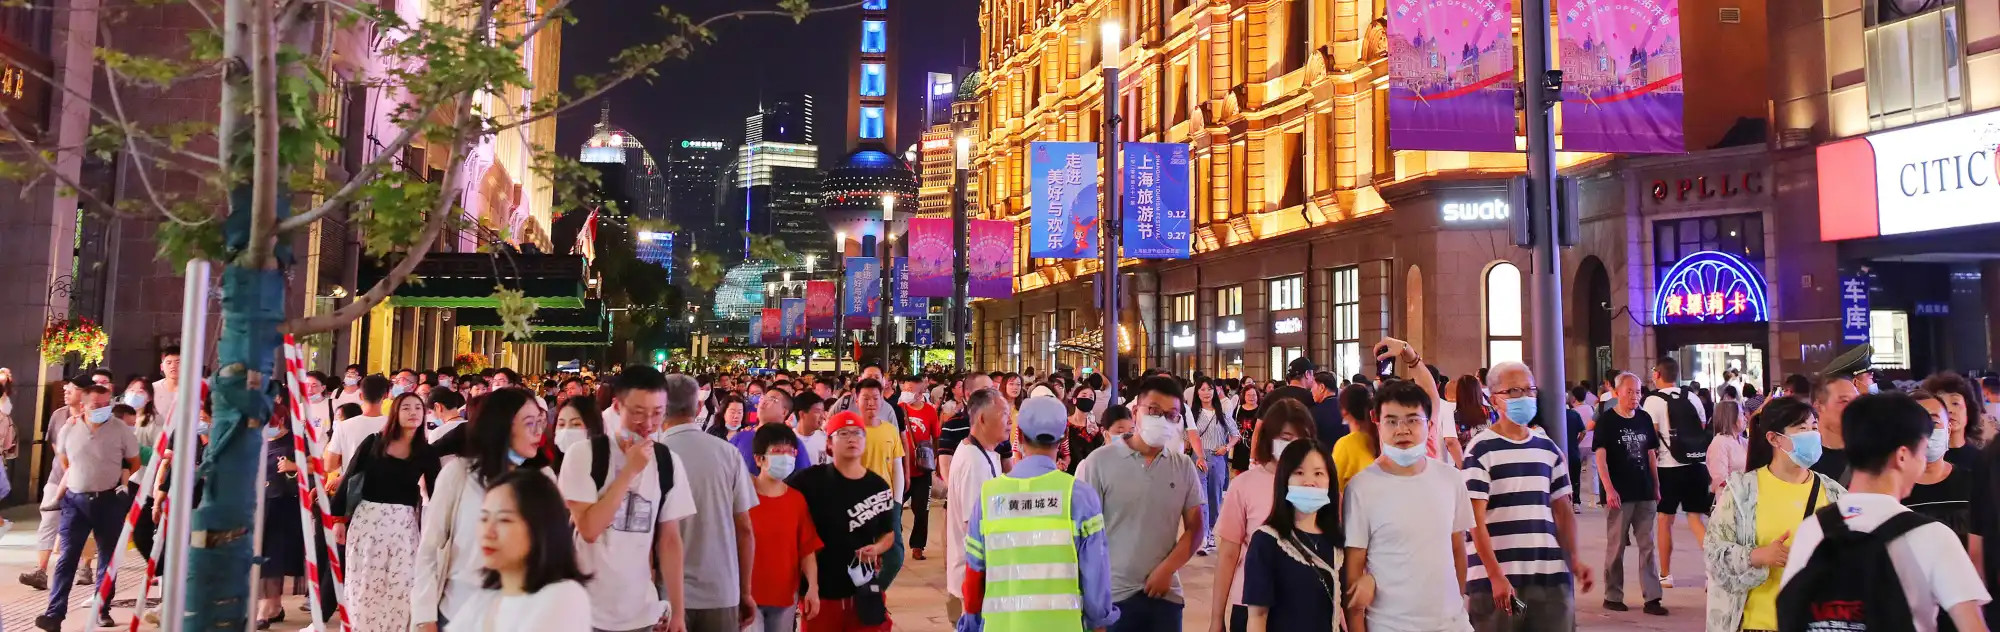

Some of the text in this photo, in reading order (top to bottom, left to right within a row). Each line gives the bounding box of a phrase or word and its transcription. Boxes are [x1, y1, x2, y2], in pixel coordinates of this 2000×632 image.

[1066, 152, 1082, 185] 走进
[1900, 150, 1988, 197] CITIC
[1047, 168, 1064, 250] 美好与欢乐
[1137, 154, 1154, 240] 上海旅游节
[1167, 210, 1187, 219] 9.12
[1167, 231, 1187, 240] 9.27
[1843, 278, 1868, 330] 车库
[847, 488, 894, 518] UNDER
[1008, 497, 1058, 511] 黄浦城发
